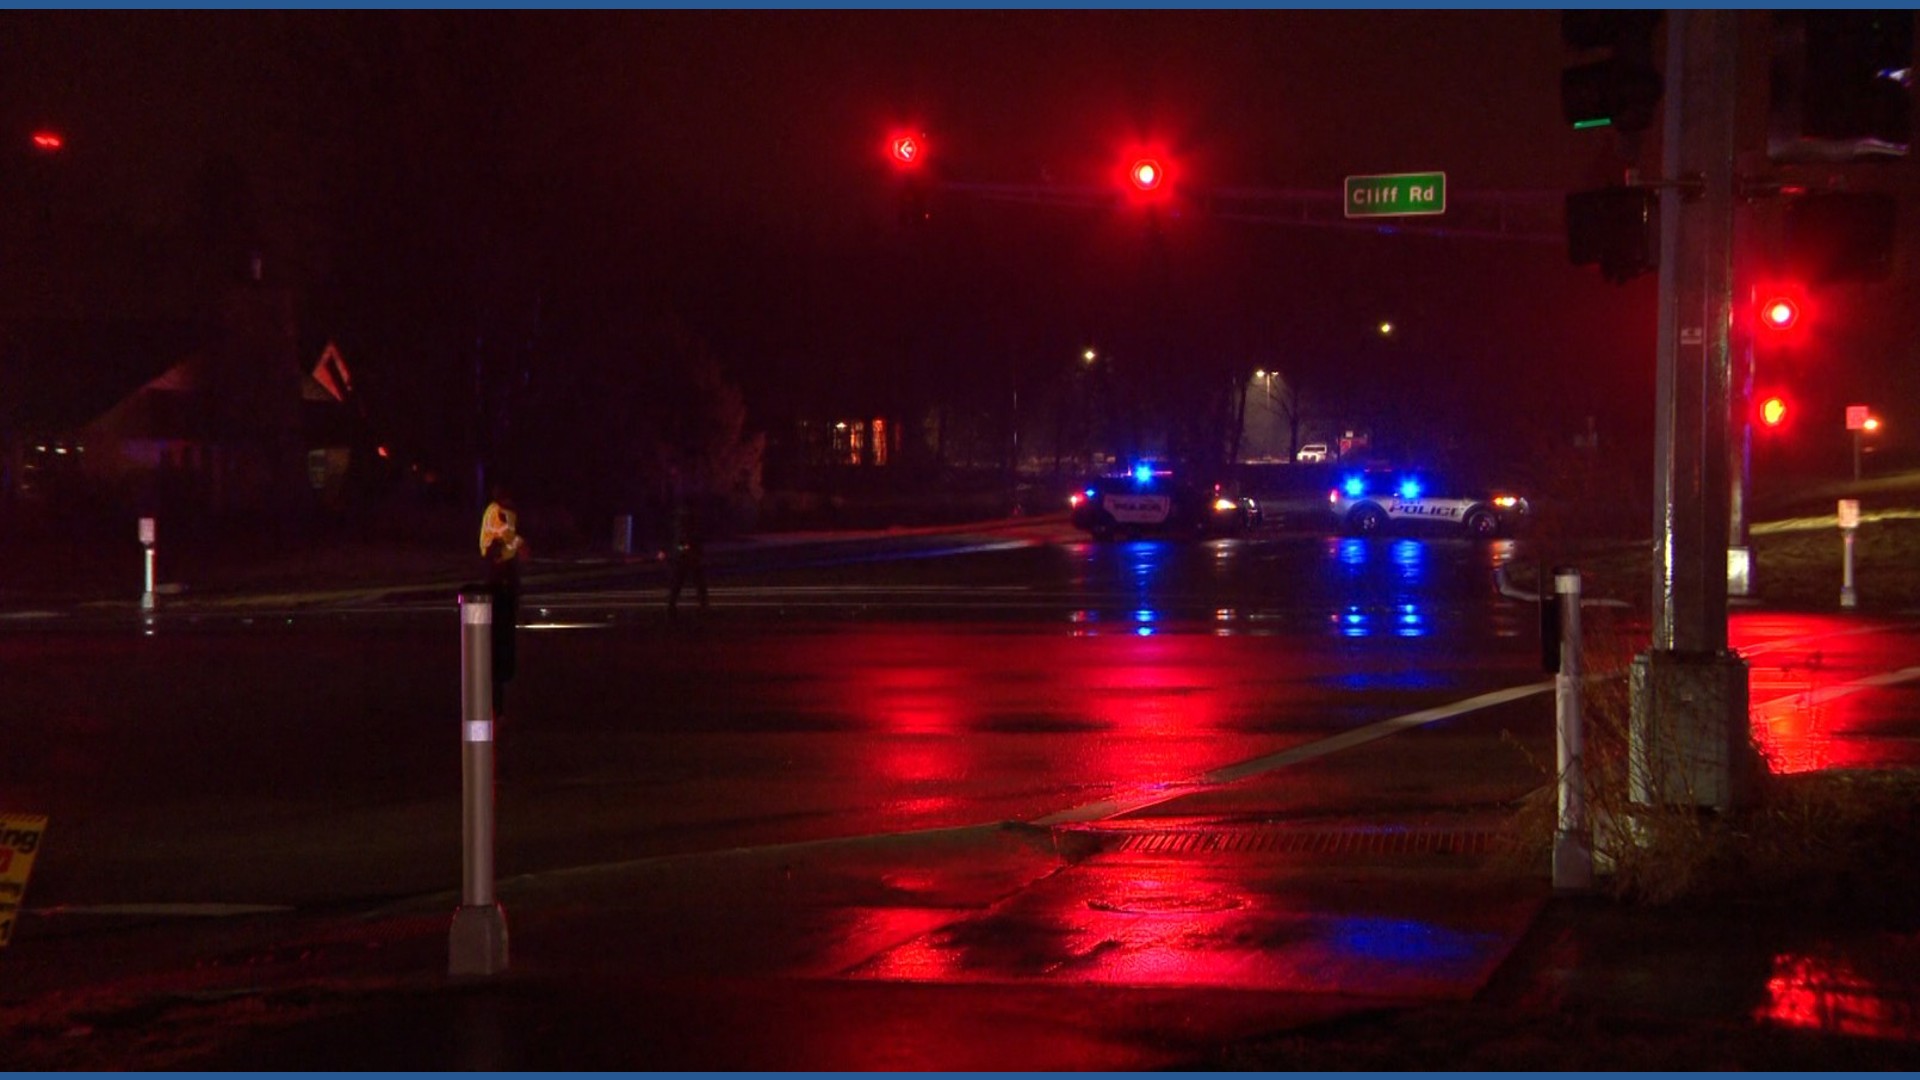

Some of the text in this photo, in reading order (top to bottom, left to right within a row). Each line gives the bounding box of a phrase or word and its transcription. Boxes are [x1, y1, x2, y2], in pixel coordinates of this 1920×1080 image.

[1353, 185, 1434, 205] Cliff Rd
[1389, 504, 1463, 517] POLICE
